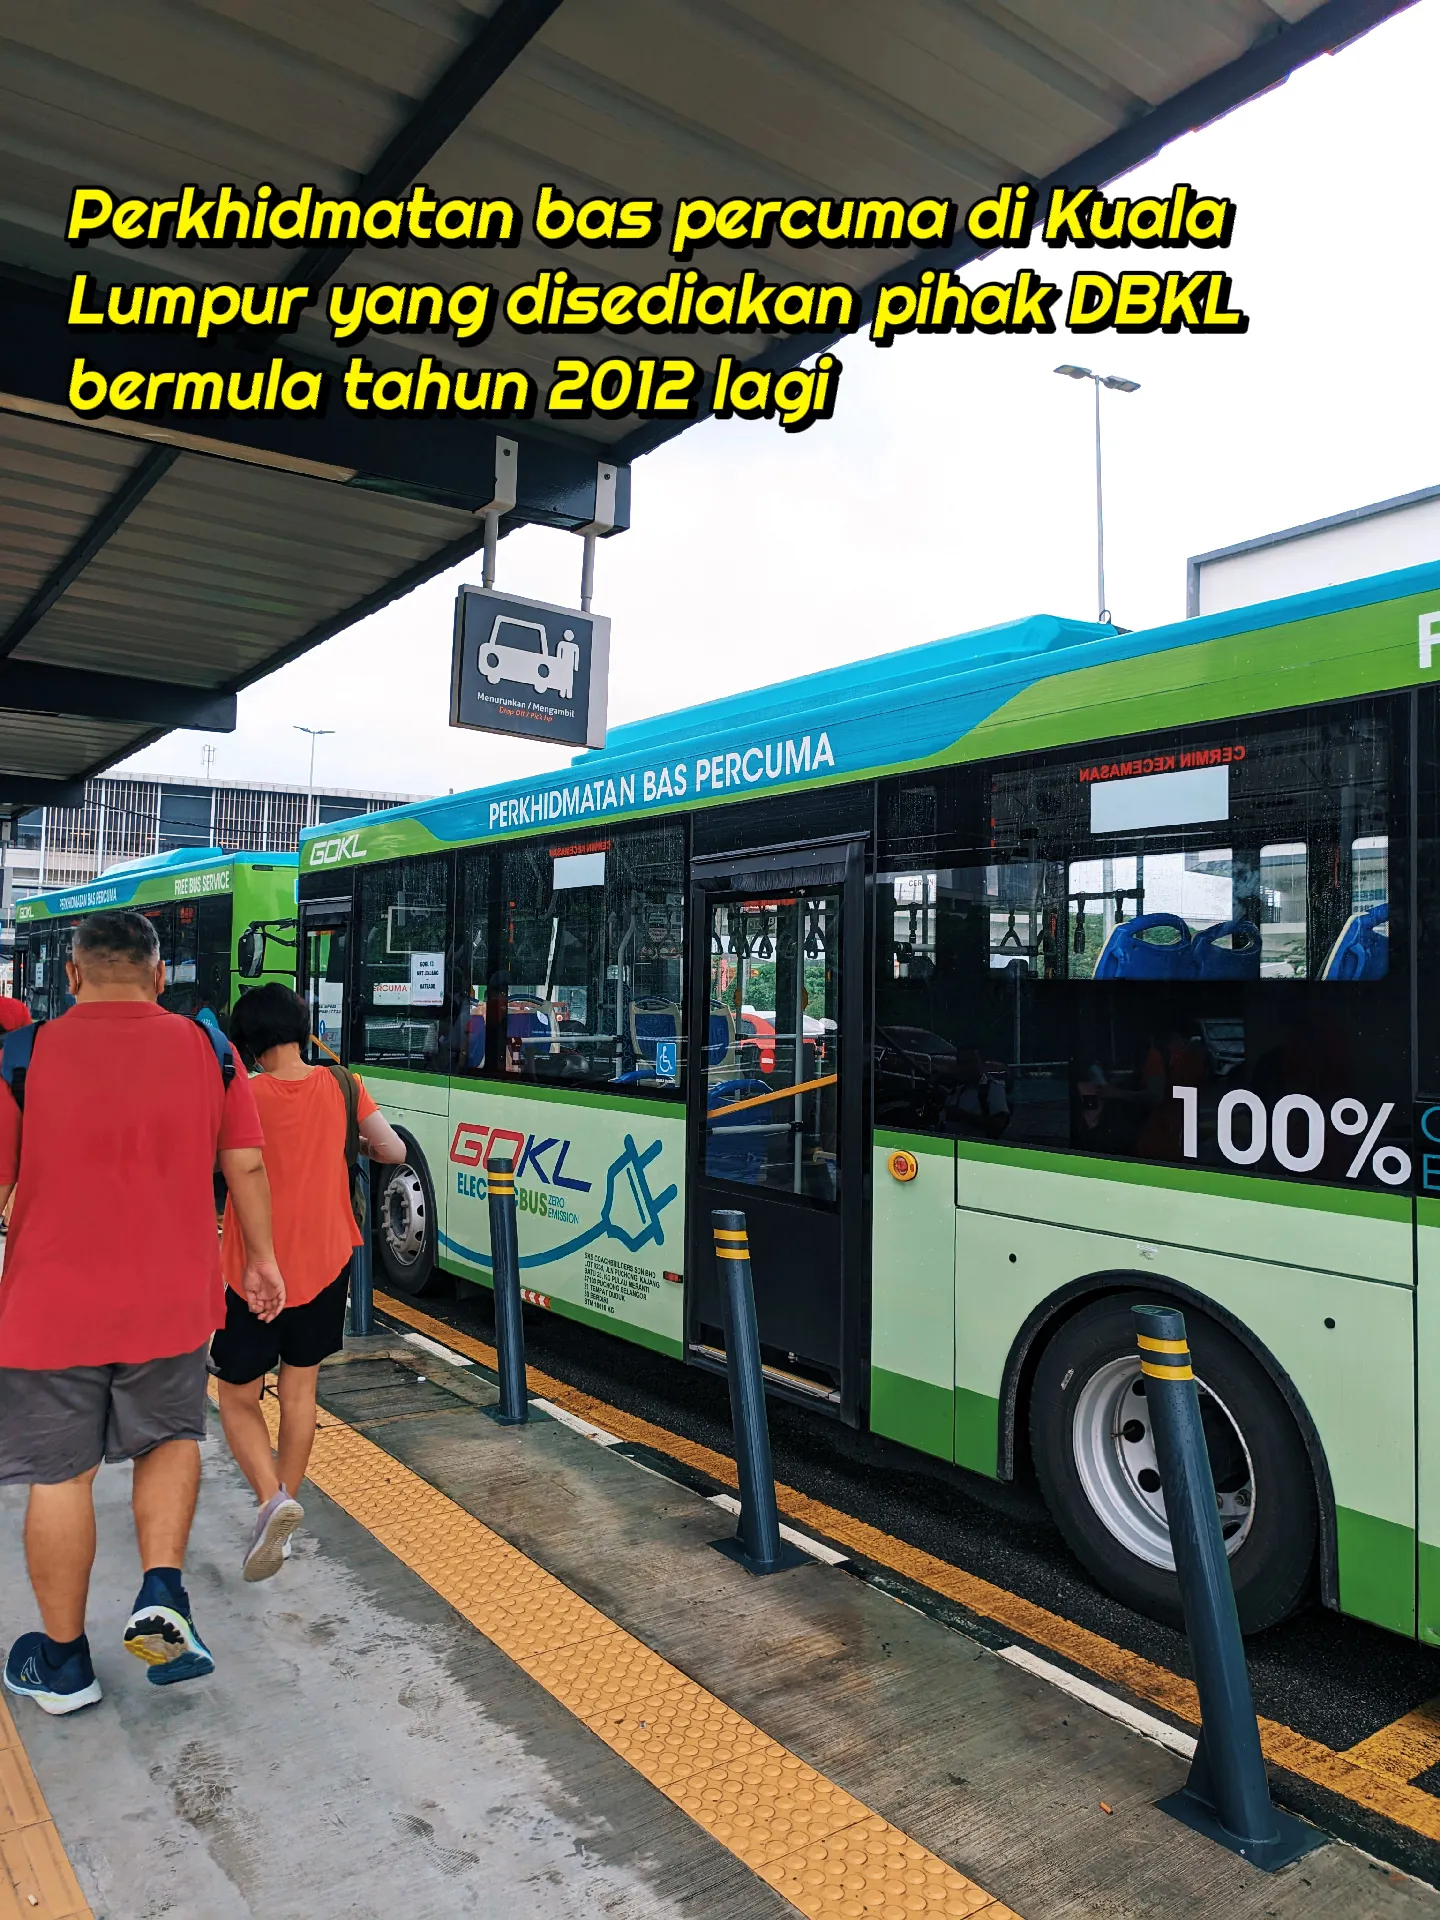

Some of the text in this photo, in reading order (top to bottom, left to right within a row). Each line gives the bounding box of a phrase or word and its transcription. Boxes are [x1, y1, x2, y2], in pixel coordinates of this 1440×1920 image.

[477, 691, 526, 708] Menurunkan
[532, 702, 575, 718] Mengambil
[499, 706, 514, 716] Drop
[530, 712, 543, 720] Pick
[489, 731, 835, 830] PERKHIDMATAN BAS PERCUMA
[309, 833, 367, 866] GOKL
[174, 871, 230, 896] FREE BUS SERVICE
[373, 984, 408, 992] ERCUMA
[1172, 1085, 1412, 1186] 100%
[450, 1122, 592, 1193] GOKL
[519, 1187, 548, 1217] BUS
[548, 1195, 565, 1209] ZERO
[548, 1207, 580, 1225] EMISSION
[584, 1267, 596, 1277] BATU
[612, 1276, 628, 1287] PULAU
[614, 1268, 638, 1281] PUCHONG
[640, 1276, 660, 1289] KAJANG
[590, 1284, 609, 1296] TEMPAT
[609, 1290, 626, 1302] DUDUK
[597, 1280, 620, 1292] PUCHONG
[620, 1286, 647, 1300] SELANGOR
